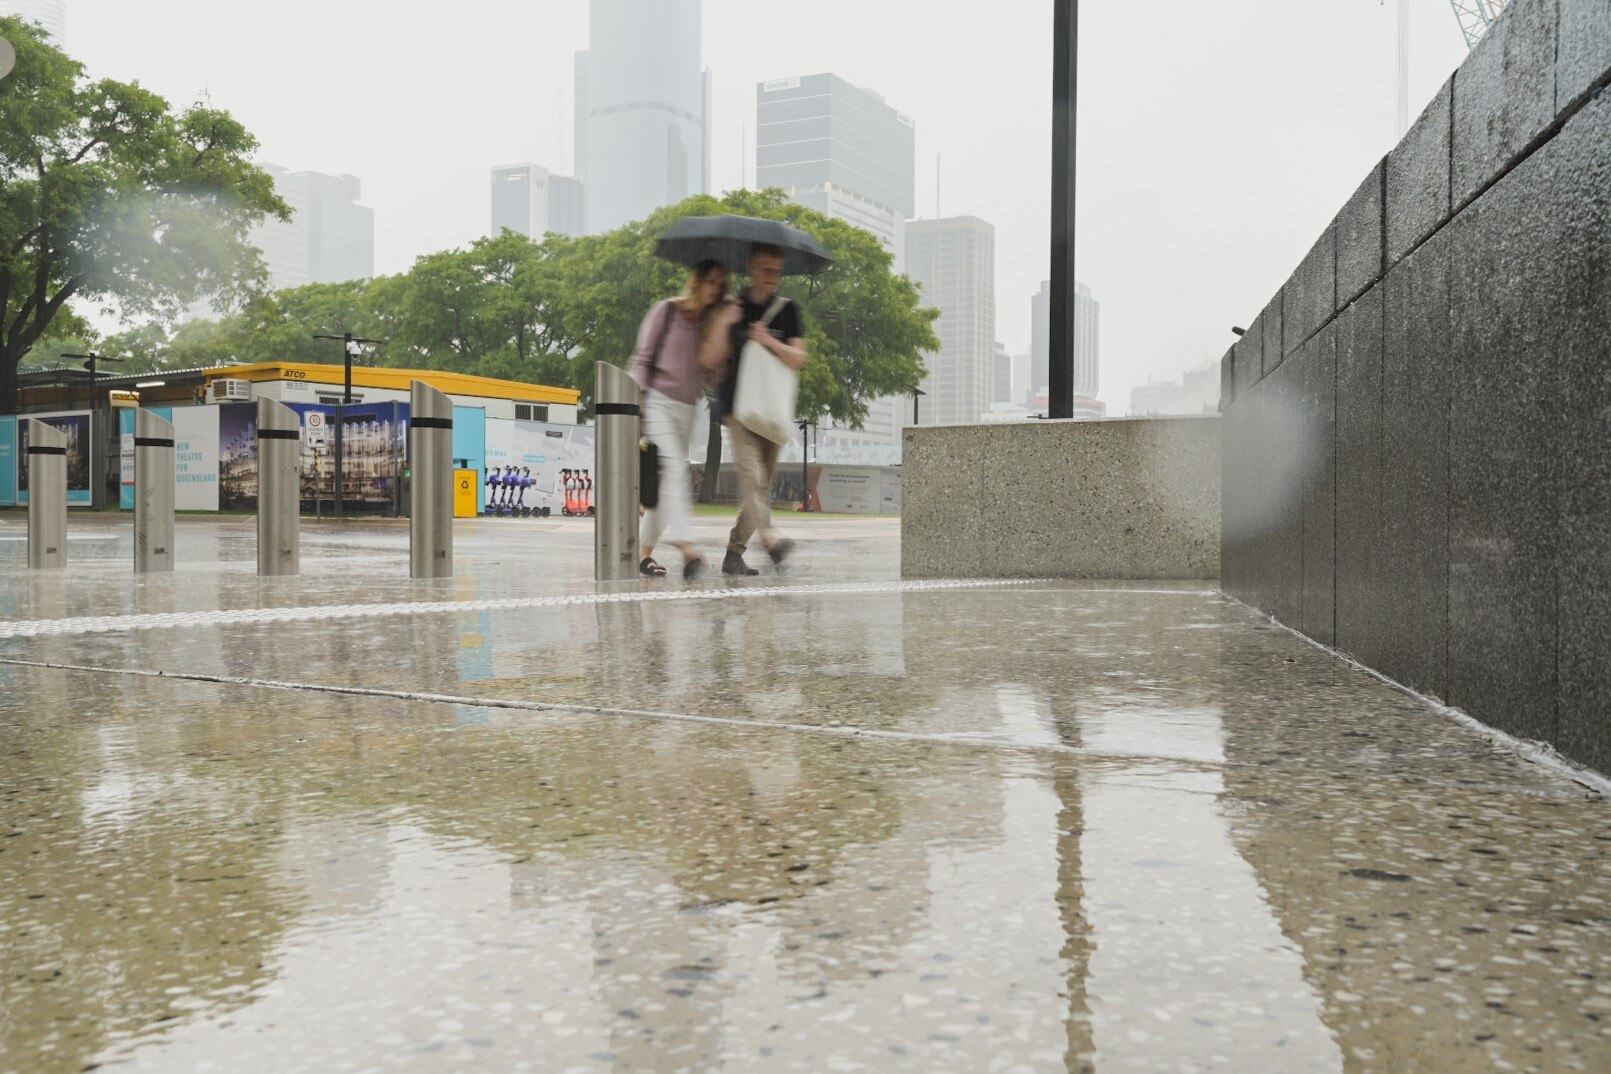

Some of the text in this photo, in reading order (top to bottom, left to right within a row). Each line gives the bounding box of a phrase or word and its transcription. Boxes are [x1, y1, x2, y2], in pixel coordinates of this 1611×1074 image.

[283, 370, 306, 379] ATCO
[176, 442, 190, 451] NEW
[176, 452, 203, 462] THEATRE
[176, 463, 188, 472] FOR
[176, 473, 216, 483] QUEENSLAND
